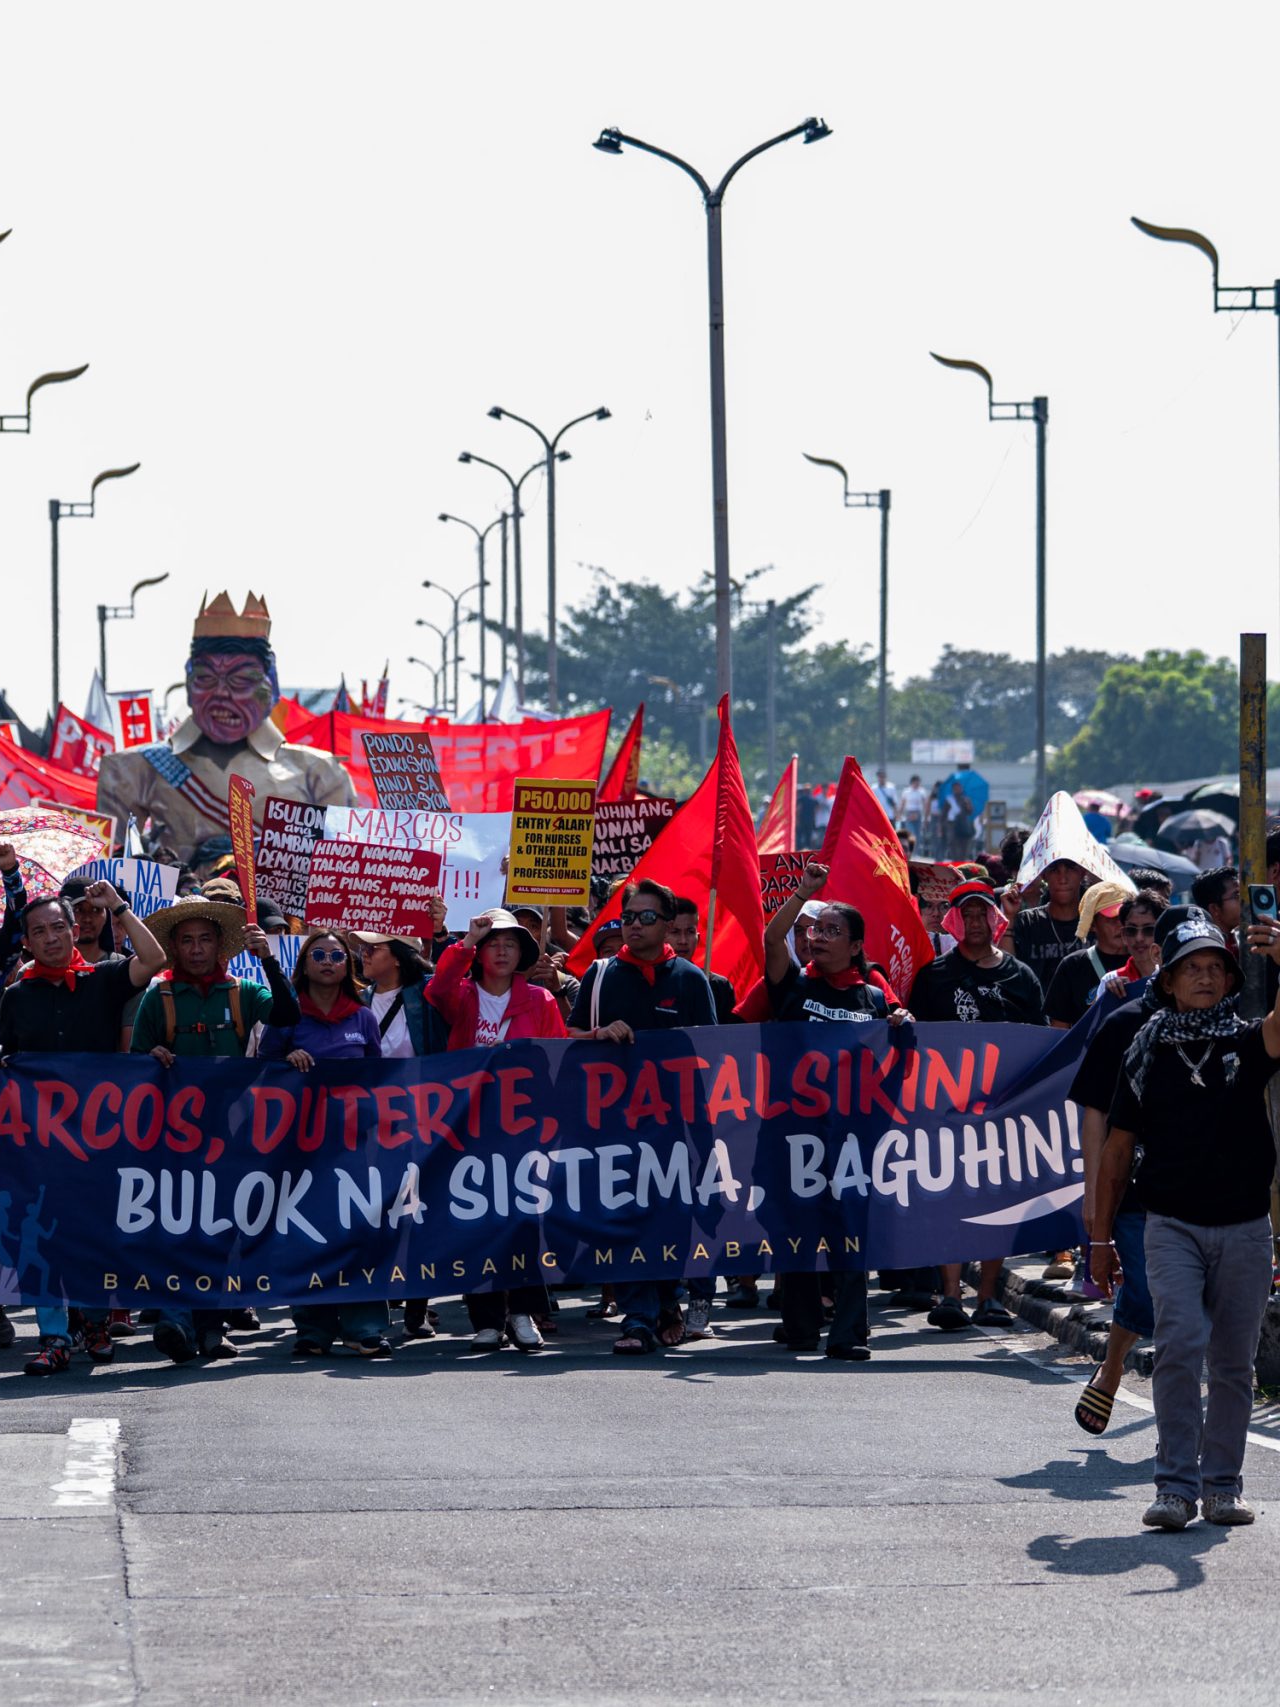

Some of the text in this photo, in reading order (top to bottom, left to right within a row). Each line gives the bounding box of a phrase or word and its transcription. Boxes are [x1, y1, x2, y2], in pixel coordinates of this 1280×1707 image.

[363, 733, 432, 755] PONDO SA
[368, 755, 440, 773] EDUKASYON
[374, 774, 439, 792] HINDI SA
[378, 791, 451, 811] KORAPSYON
[520, 790, 591, 812] P50,000
[594, 801, 674, 820] UHIN ANG
[268, 800, 327, 831] ISULON
[516, 816, 592, 831] ENTRY SALARY
[284, 823, 317, 839] ang
[348, 809, 463, 843] MARCOS
[595, 819, 645, 840] UNAN
[263, 829, 317, 855] PAMBAN
[525, 832, 581, 845] FOR NURSES
[315, 842, 357, 858] HINDI
[361, 845, 414, 863] NAMAN
[517, 844, 588, 857] & OTHER ALLIED
[312, 857, 430, 881] TALAGA MAHIRAP
[534, 857, 569, 868] HEALTH
[136, 859, 163, 898] NA
[308, 874, 337, 889] ANG
[514, 867, 587, 880] PROFESSIONALS
[255, 873, 308, 896] SOSYALIST
[256, 888, 307, 909] PERSPEKT
[308, 891, 343, 906] LANG
[347, 894, 398, 910] TALAGA
[341, 907, 395, 925] KORAP!
[362, 920, 415, 936] PARTYLIST
[823, 1009, 836, 1019] THE
[249, 1066, 558, 1152] DUTERTE,
[582, 1043, 1001, 1130] PATALSIKIN!
[116, 1099, 1086, 1245] BULOK NA SISTEMA, BAGUHIN!
[104, 1235, 861, 1293] BAGONG ALYANSANG MAKABAYAN
